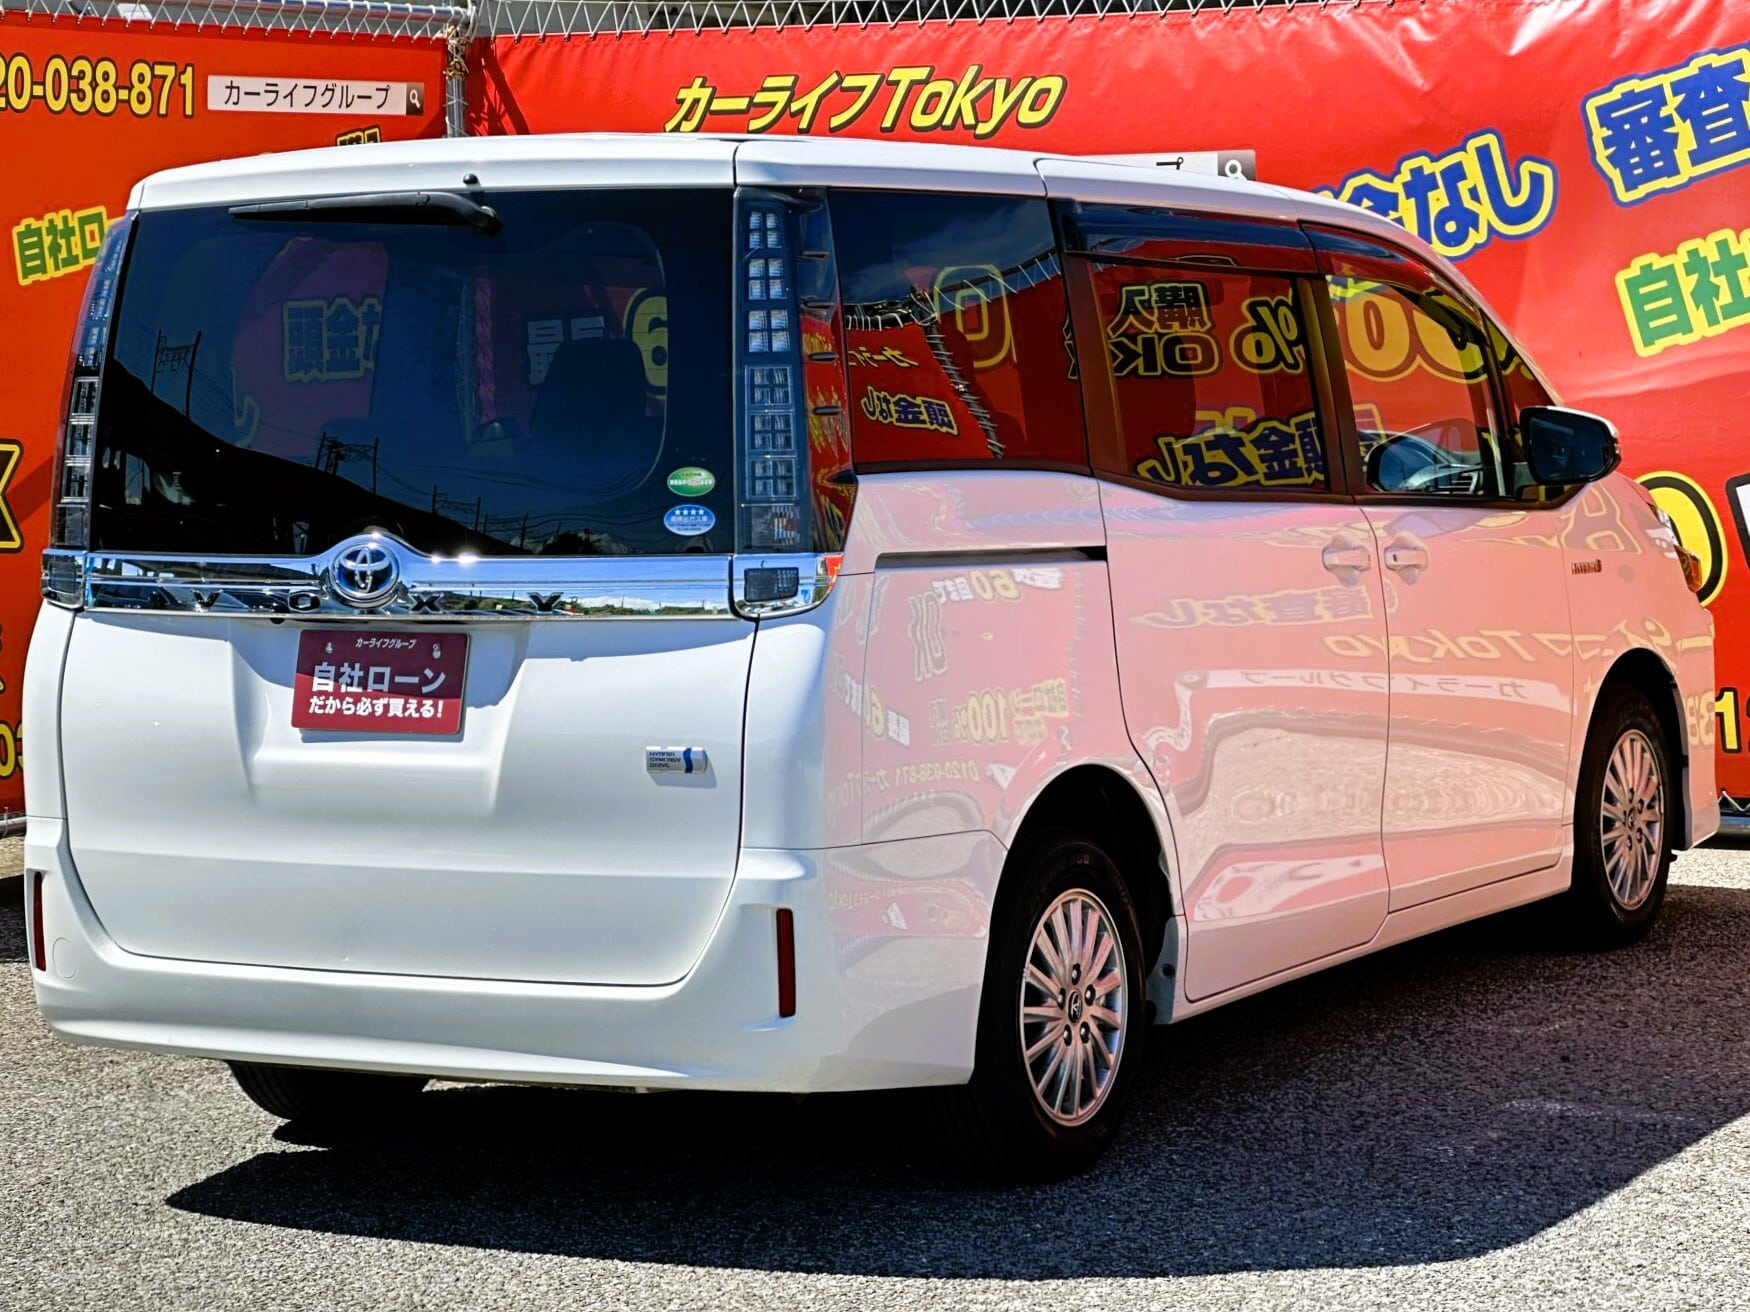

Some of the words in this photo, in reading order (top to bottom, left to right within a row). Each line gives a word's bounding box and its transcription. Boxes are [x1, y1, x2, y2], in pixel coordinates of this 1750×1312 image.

[224, 80, 391, 111] カーライフグループ
[665, 65, 1066, 138] カーライフTokyo
[355, 637, 417, 650] カーライフグループ
[311, 661, 446, 694] 自社ローン
